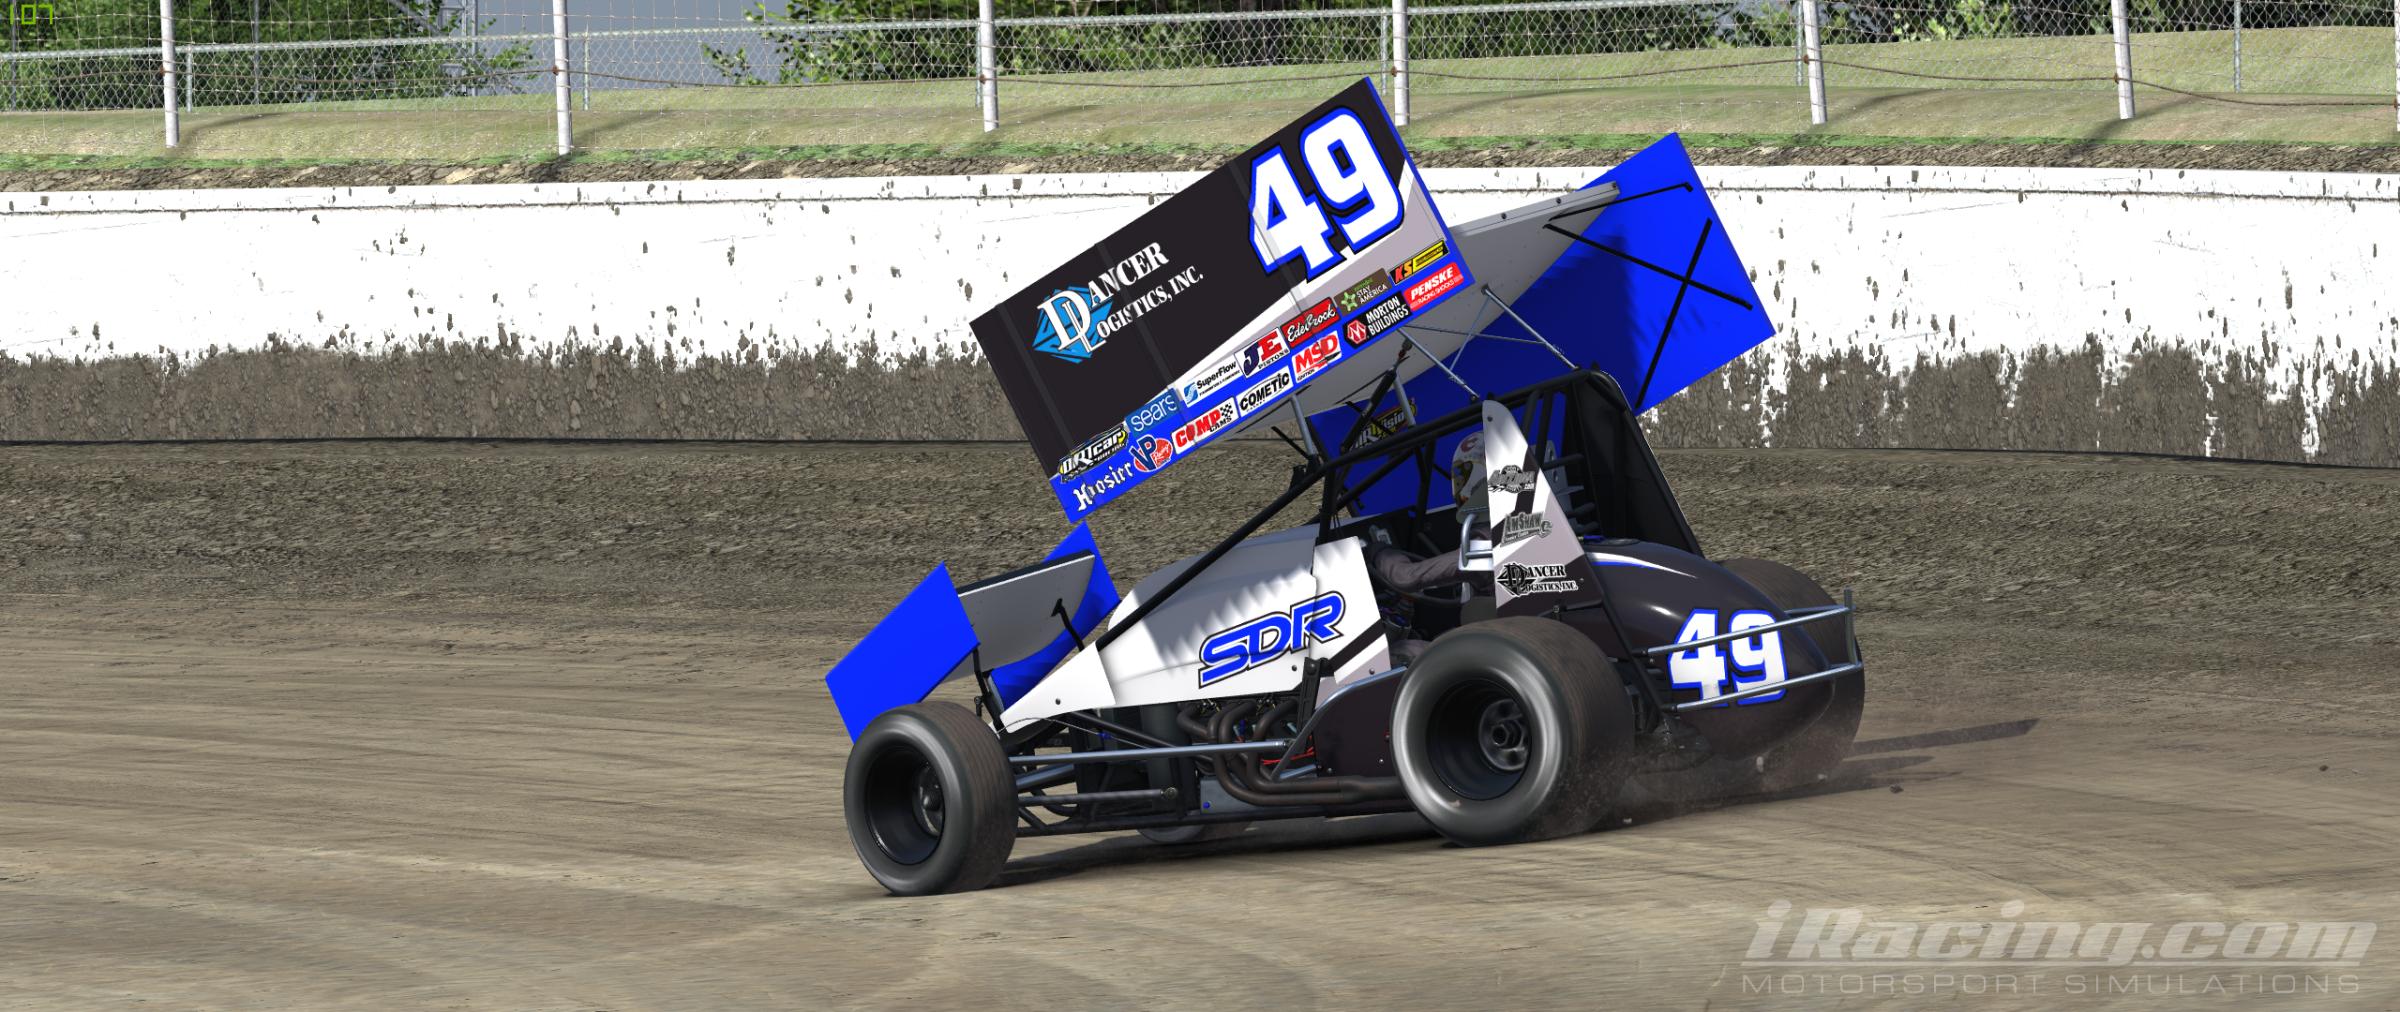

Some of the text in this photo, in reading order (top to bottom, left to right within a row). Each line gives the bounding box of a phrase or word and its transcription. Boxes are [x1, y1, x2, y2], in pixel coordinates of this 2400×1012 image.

[1249, 107, 1404, 282] 49
[1037, 242, 1169, 351] DANCER
[1168, 265, 1204, 296] INC.
[1356, 285, 1371, 298] STAY
[1360, 283, 1388, 304] AMERICA
[1410, 267, 1453, 300] PENSKE
[1287, 304, 1336, 342] Edelbrock
[1366, 296, 1401, 324] MORTON
[1368, 304, 1409, 336] BUILDINGS
[1243, 330, 1283, 376] JE
[1295, 334, 1338, 374] MSD
[1196, 361, 1237, 390] SuperFlow
[1239, 372, 1290, 411] COMETIC
[1131, 395, 1178, 432] sears
[1175, 409, 1222, 448] COMP
[1209, 416, 1233, 434] CAMS
[1129, 434, 1158, 472] VP
[1503, 563, 1566, 588] DANCER
[1199, 591, 1345, 689] SDR
[1668, 608, 1788, 707] 49
